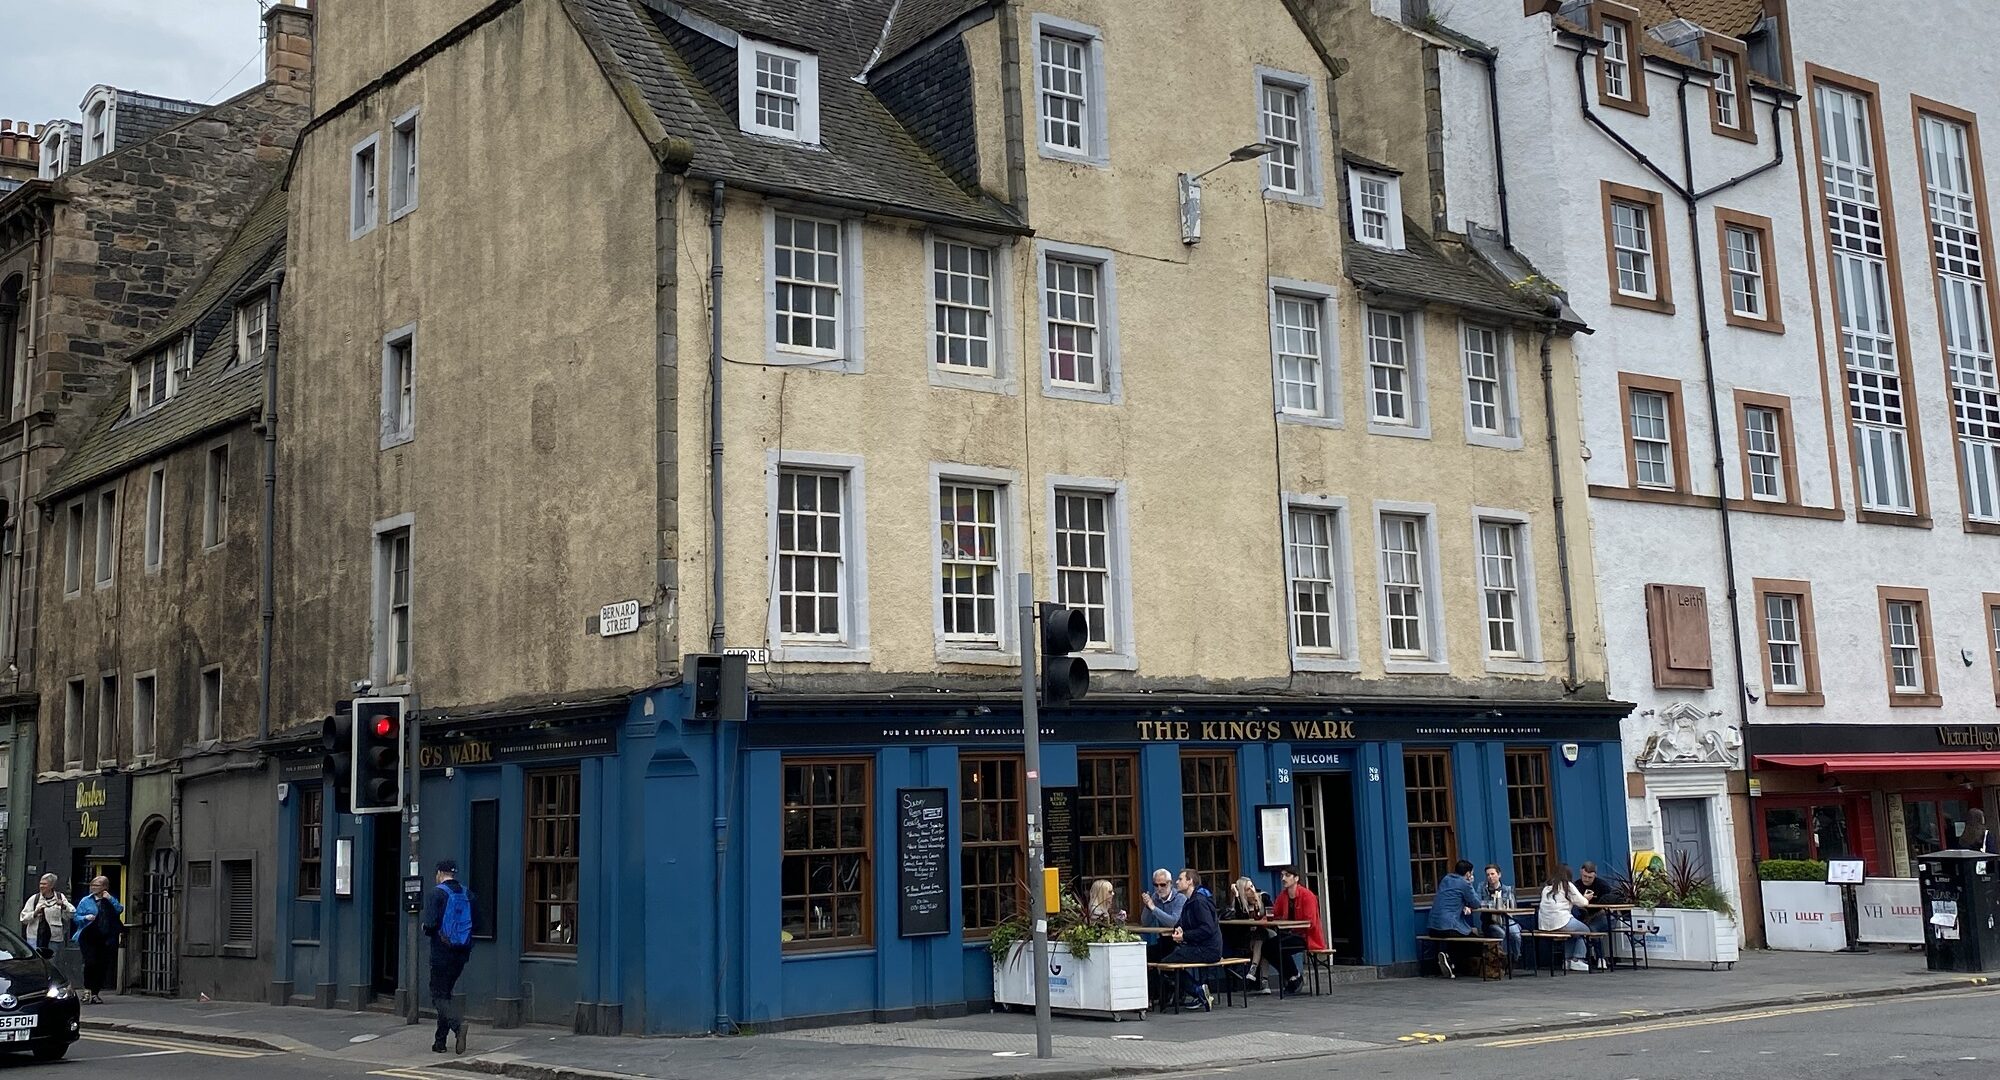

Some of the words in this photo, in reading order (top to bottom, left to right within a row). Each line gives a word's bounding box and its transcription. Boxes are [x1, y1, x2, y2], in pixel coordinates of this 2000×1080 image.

[1678, 592, 1703, 607] Leith
[602, 603, 636, 620] BERNARD
[606, 617, 632, 633] STREET
[1137, 721, 1190, 741] THE
[1201, 720, 1281, 741] KING'S
[1291, 720, 1356, 740] WARK
[449, 741, 493, 765] WARK
[500, 745, 535, 753] TRADITIONAL
[536, 742, 562, 750] SCOTTISH
[1291, 754, 1340, 764] WELCOME
[1278, 775, 1290, 784] 36
[1369, 773, 1380, 782] 36
[76, 780, 106, 808] Barbers
[80, 811, 98, 838] Den
[1770, 911, 1788, 924] VH
[1795, 911, 1825, 921] LILLET
[1864, 905, 1883, 918] VH
[15, 1016, 33, 1026] POH
